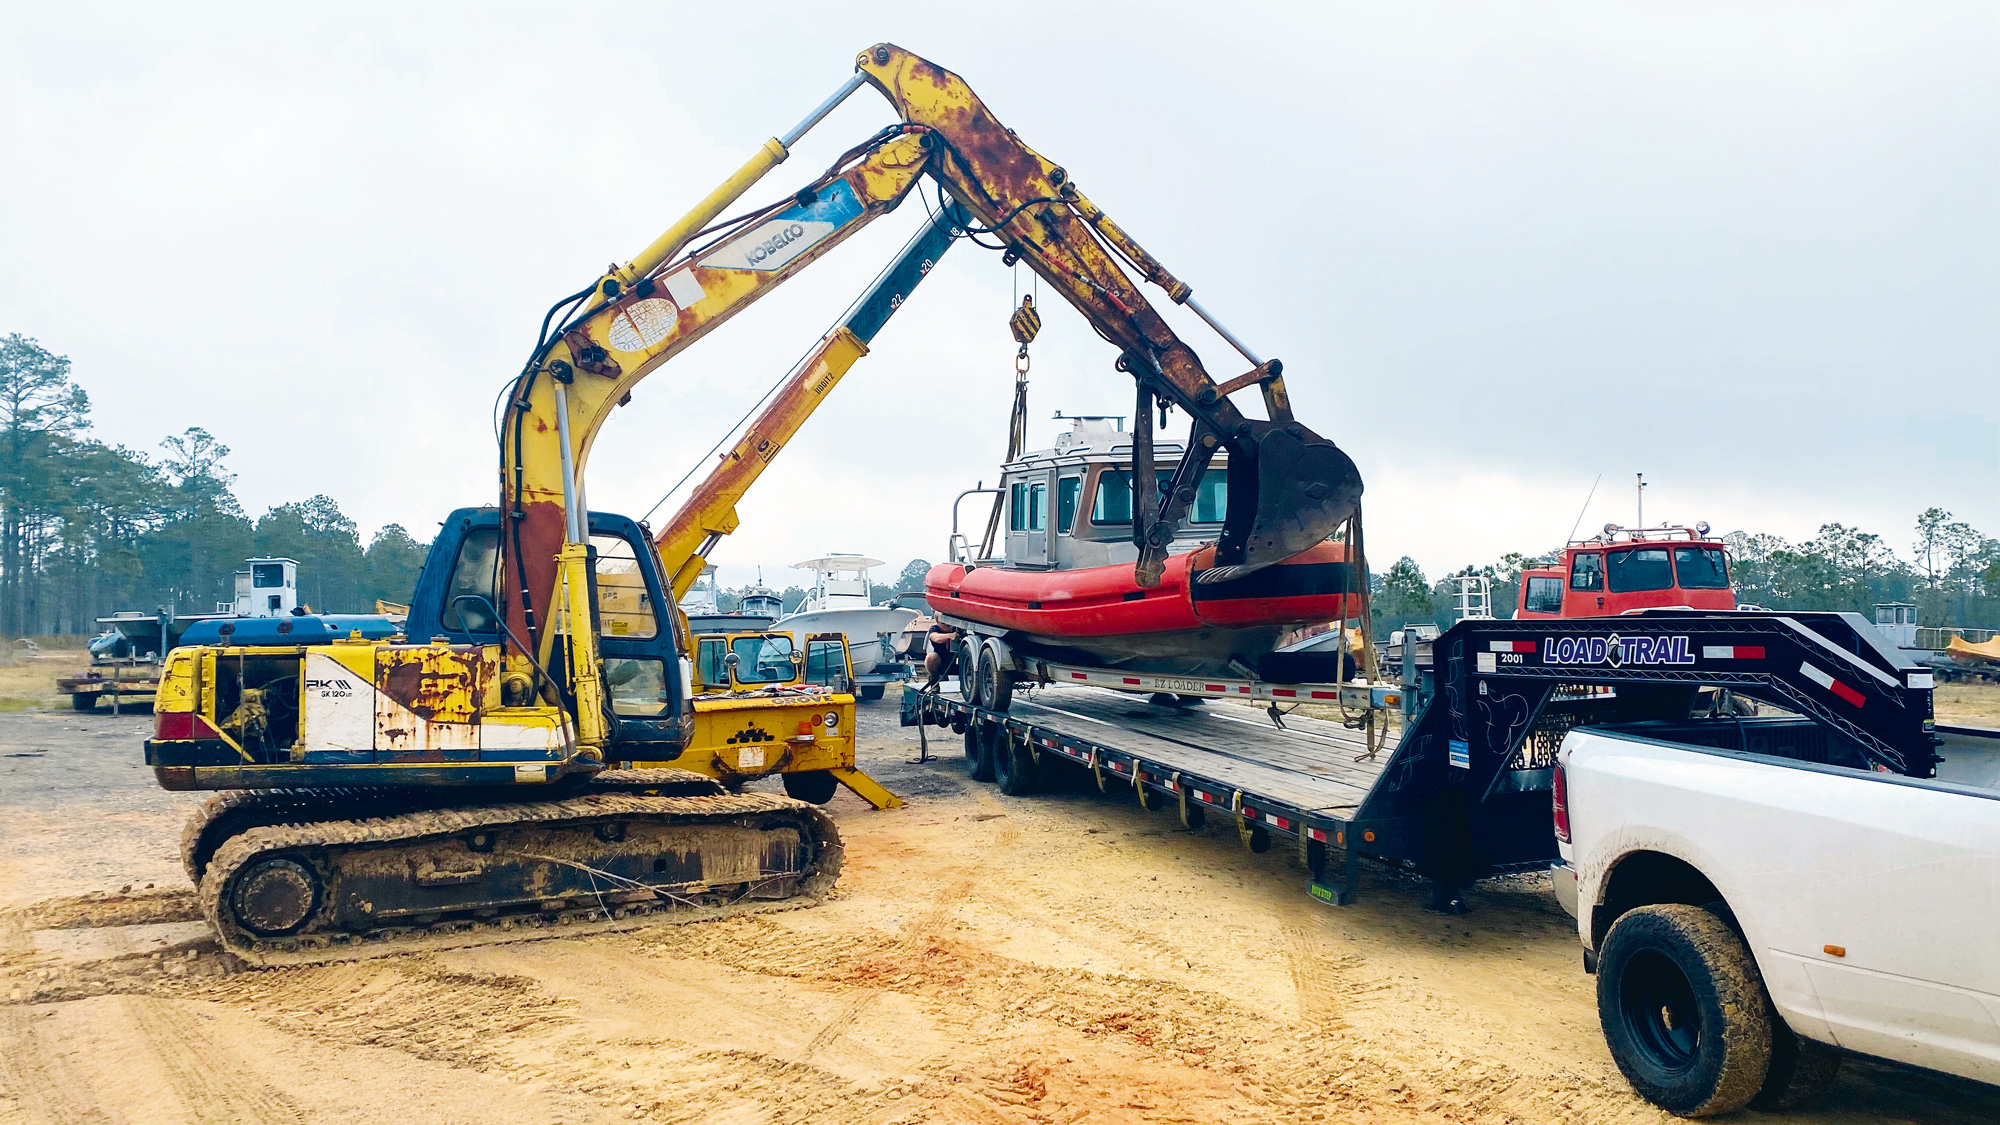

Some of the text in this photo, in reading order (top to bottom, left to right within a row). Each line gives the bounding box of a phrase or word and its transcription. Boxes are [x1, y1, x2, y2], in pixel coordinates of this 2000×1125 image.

[745, 223, 804, 267] KOBELCO
[921, 258, 934, 272] 20
[891, 293, 904, 307] 22
[757, 438, 770, 453] G
[1543, 636, 1695, 665] LOAD TRAIL
[1501, 653, 1523, 664] 2001
[1154, 678, 1205, 692] EZ LOADER
[321, 690, 331, 698] SK
[771, 694, 835, 705] GROVE
